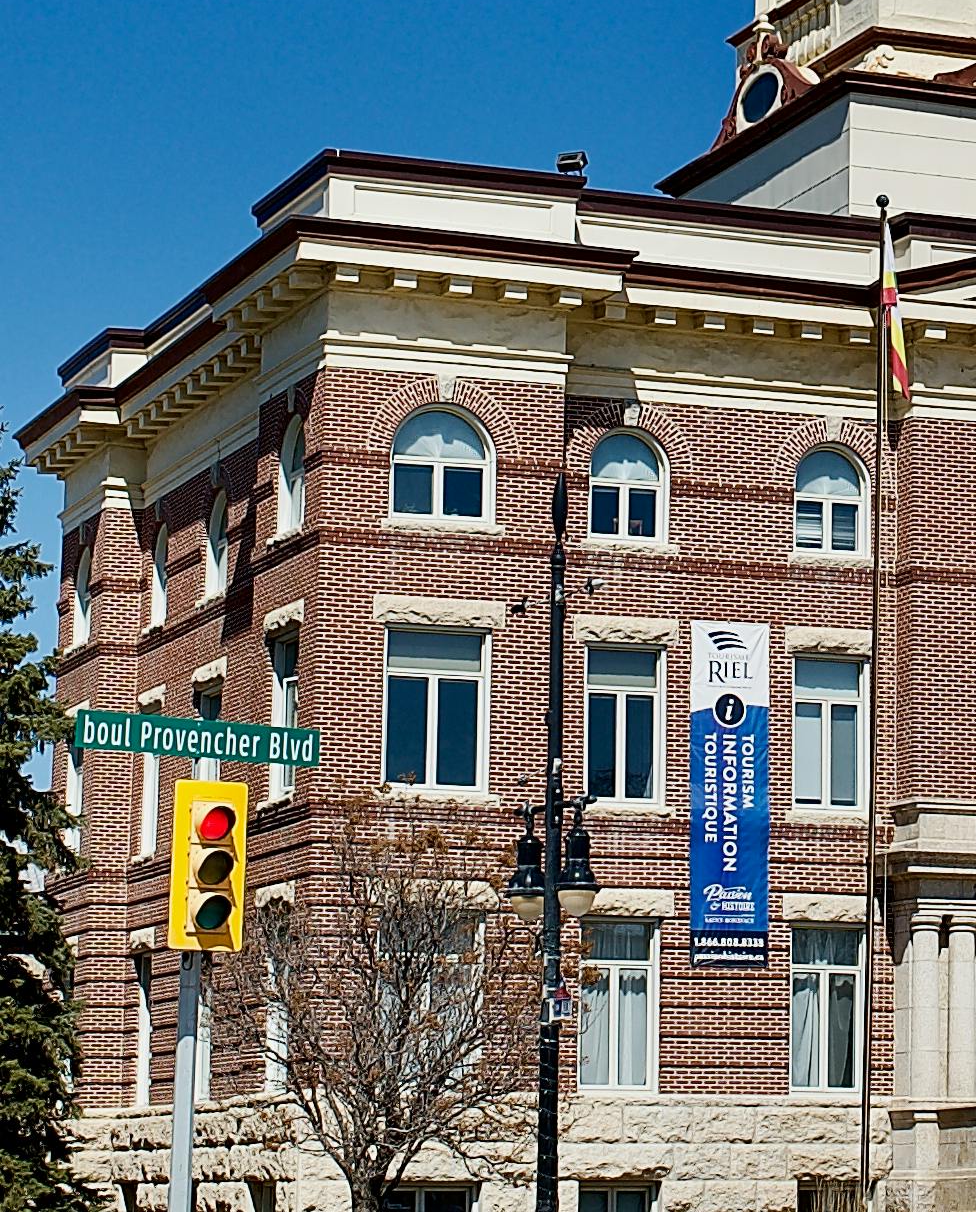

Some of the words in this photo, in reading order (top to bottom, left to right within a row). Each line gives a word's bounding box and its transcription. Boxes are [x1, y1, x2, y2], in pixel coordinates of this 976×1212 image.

[708, 660, 753, 683] RIEL
[83, 715, 131, 747] boul
[140, 721, 261, 757] Provencher
[269, 731, 315, 762] Blvd
[741, 734, 755, 809] TOURISM
[702, 732, 718, 843] TOURISTIQUE
[722, 734, 738, 872] INFORMATION
